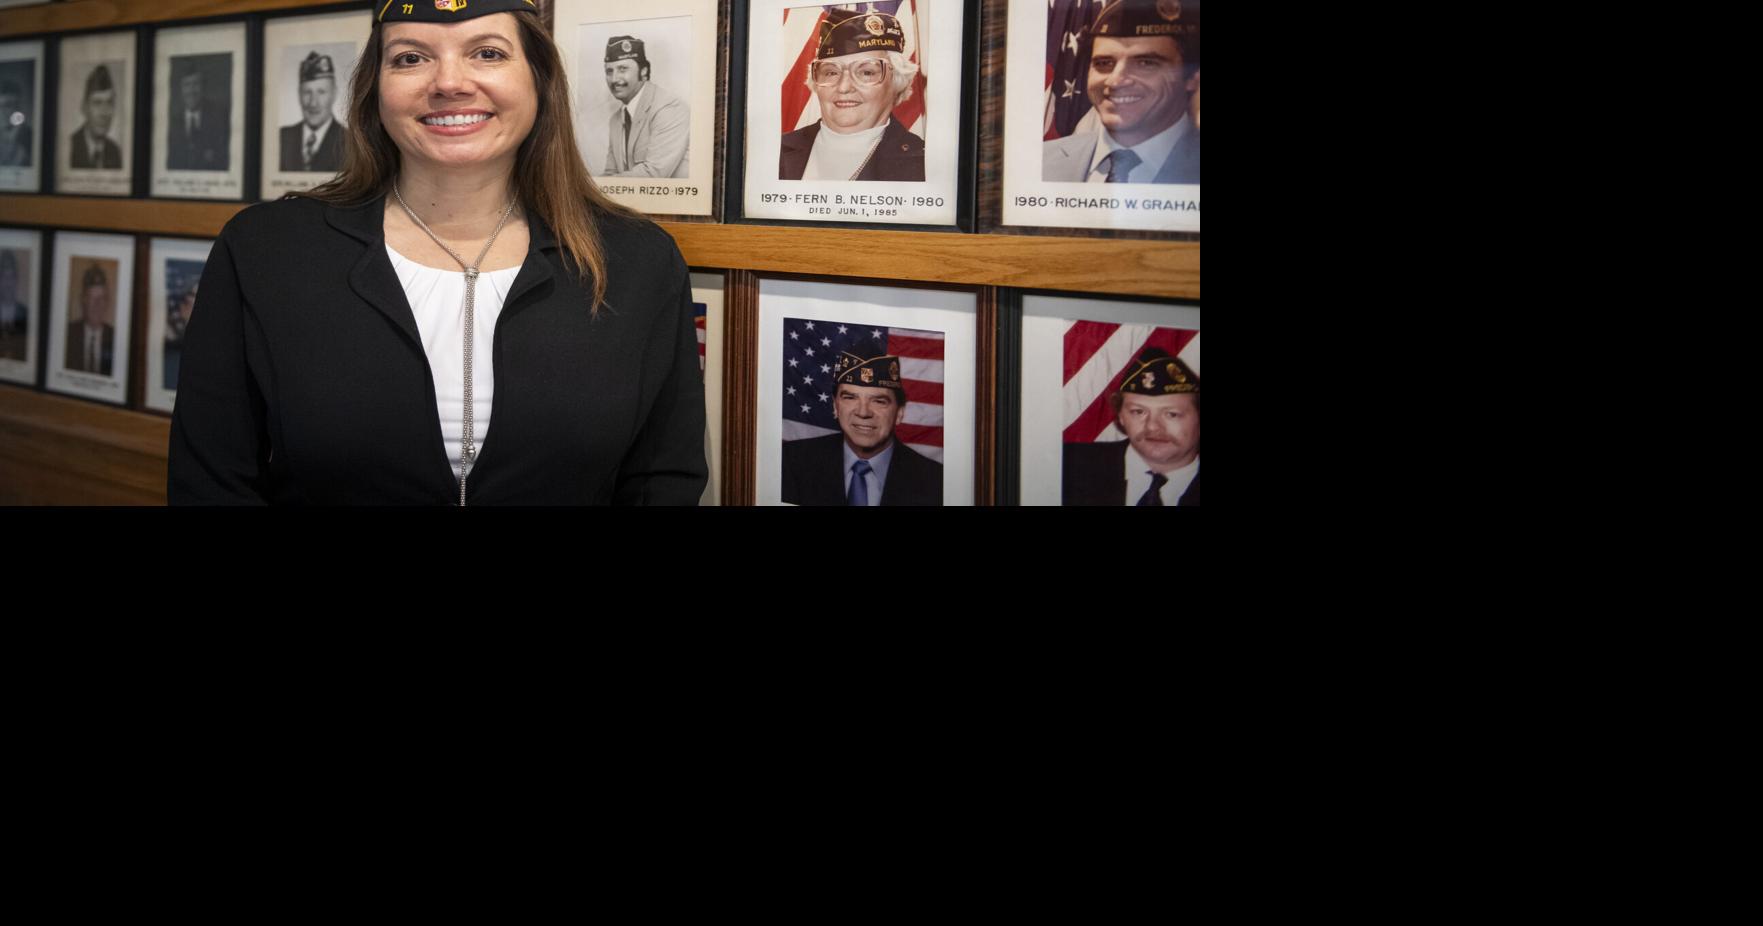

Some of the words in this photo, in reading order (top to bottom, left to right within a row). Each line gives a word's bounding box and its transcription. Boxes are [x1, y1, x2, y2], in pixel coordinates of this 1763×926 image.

[402, 4, 413, 15] 11
[858, 38, 896, 49] MARYLAND
[639, 186, 670, 195] RIZZO
[795, 194, 828, 204] FERN
[835, 195, 846, 205] B.
[912, 196, 944, 207] 1980
[1055, 197, 1119, 209] RICHARD
[1142, 199, 1200, 211] GRAHA
[809, 207, 832, 215] DIED
[838, 208, 858, 216] JUN.
[874, 209, 898, 217] 1985
